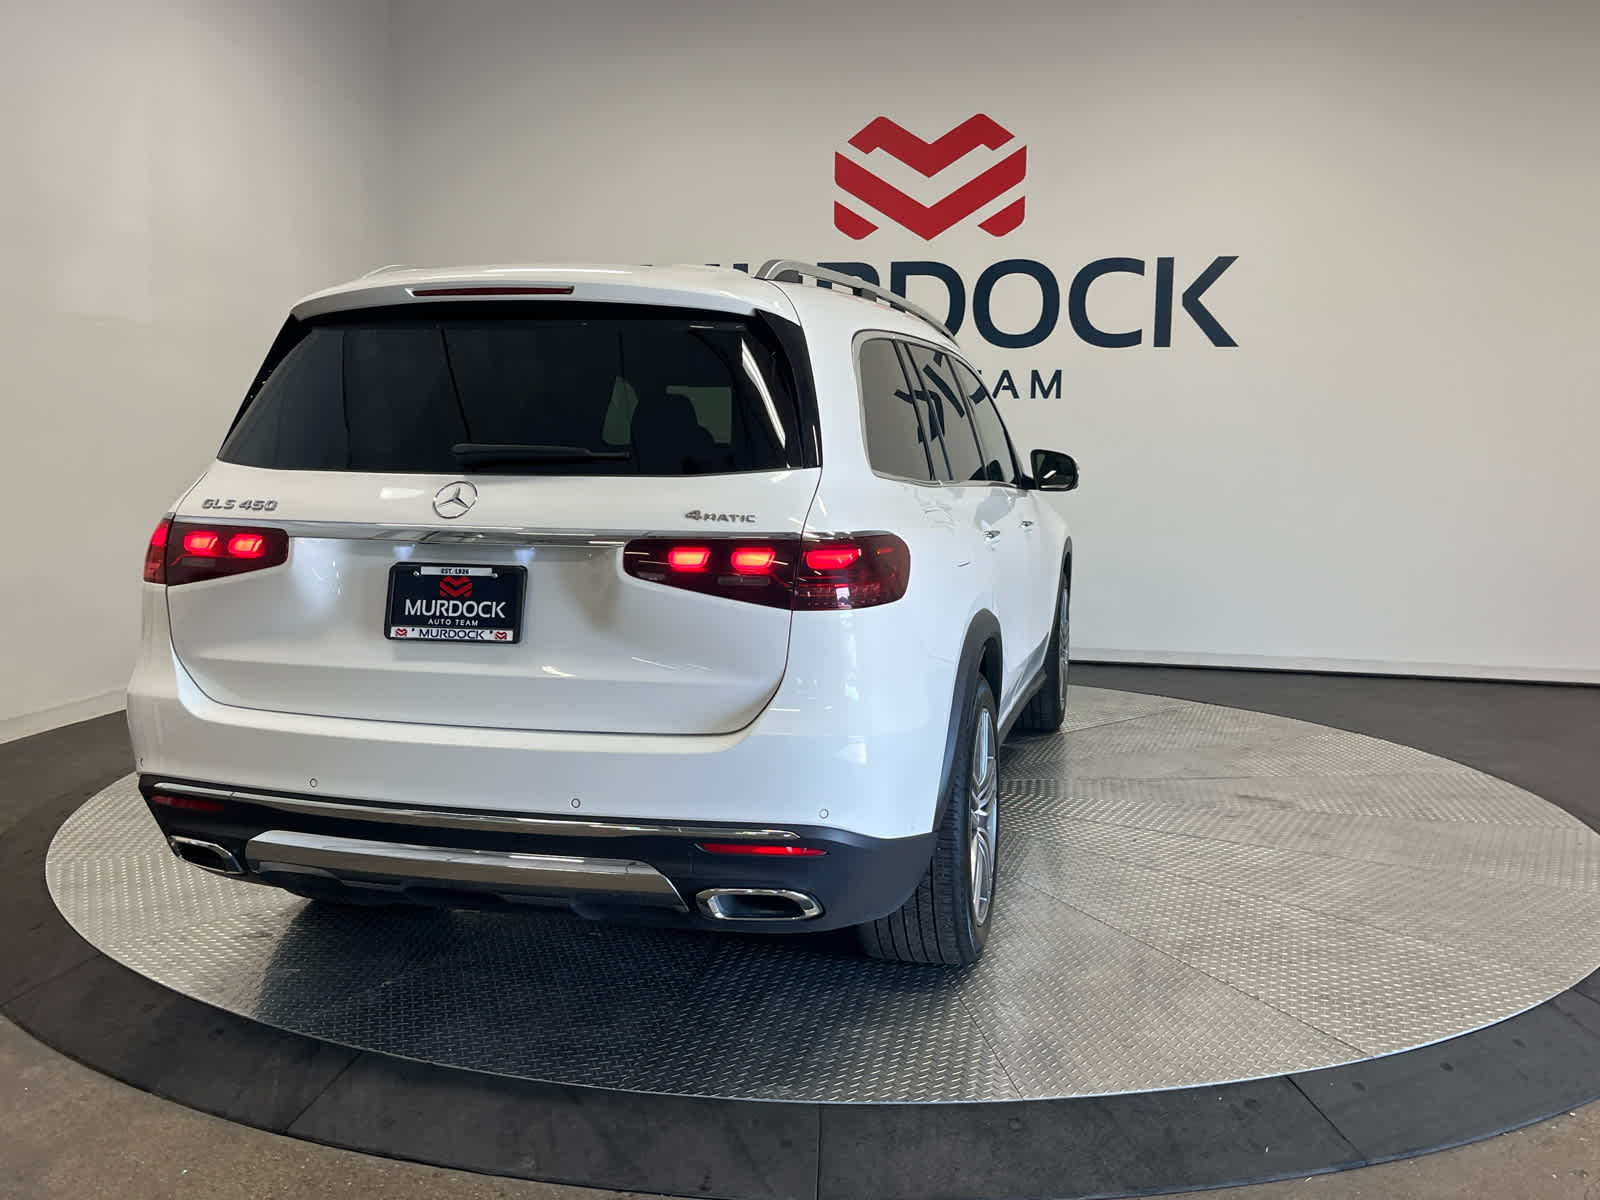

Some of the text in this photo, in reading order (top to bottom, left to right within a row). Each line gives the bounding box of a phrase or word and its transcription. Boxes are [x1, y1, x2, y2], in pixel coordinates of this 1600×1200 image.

[640, 255, 1239, 348] DOCK
[202, 498, 278, 511] GLS 450
[685, 509, 756, 523] 4MATIC
[405, 599, 506, 618] MURDOCK
[419, 628, 485, 640] MURDOCK
